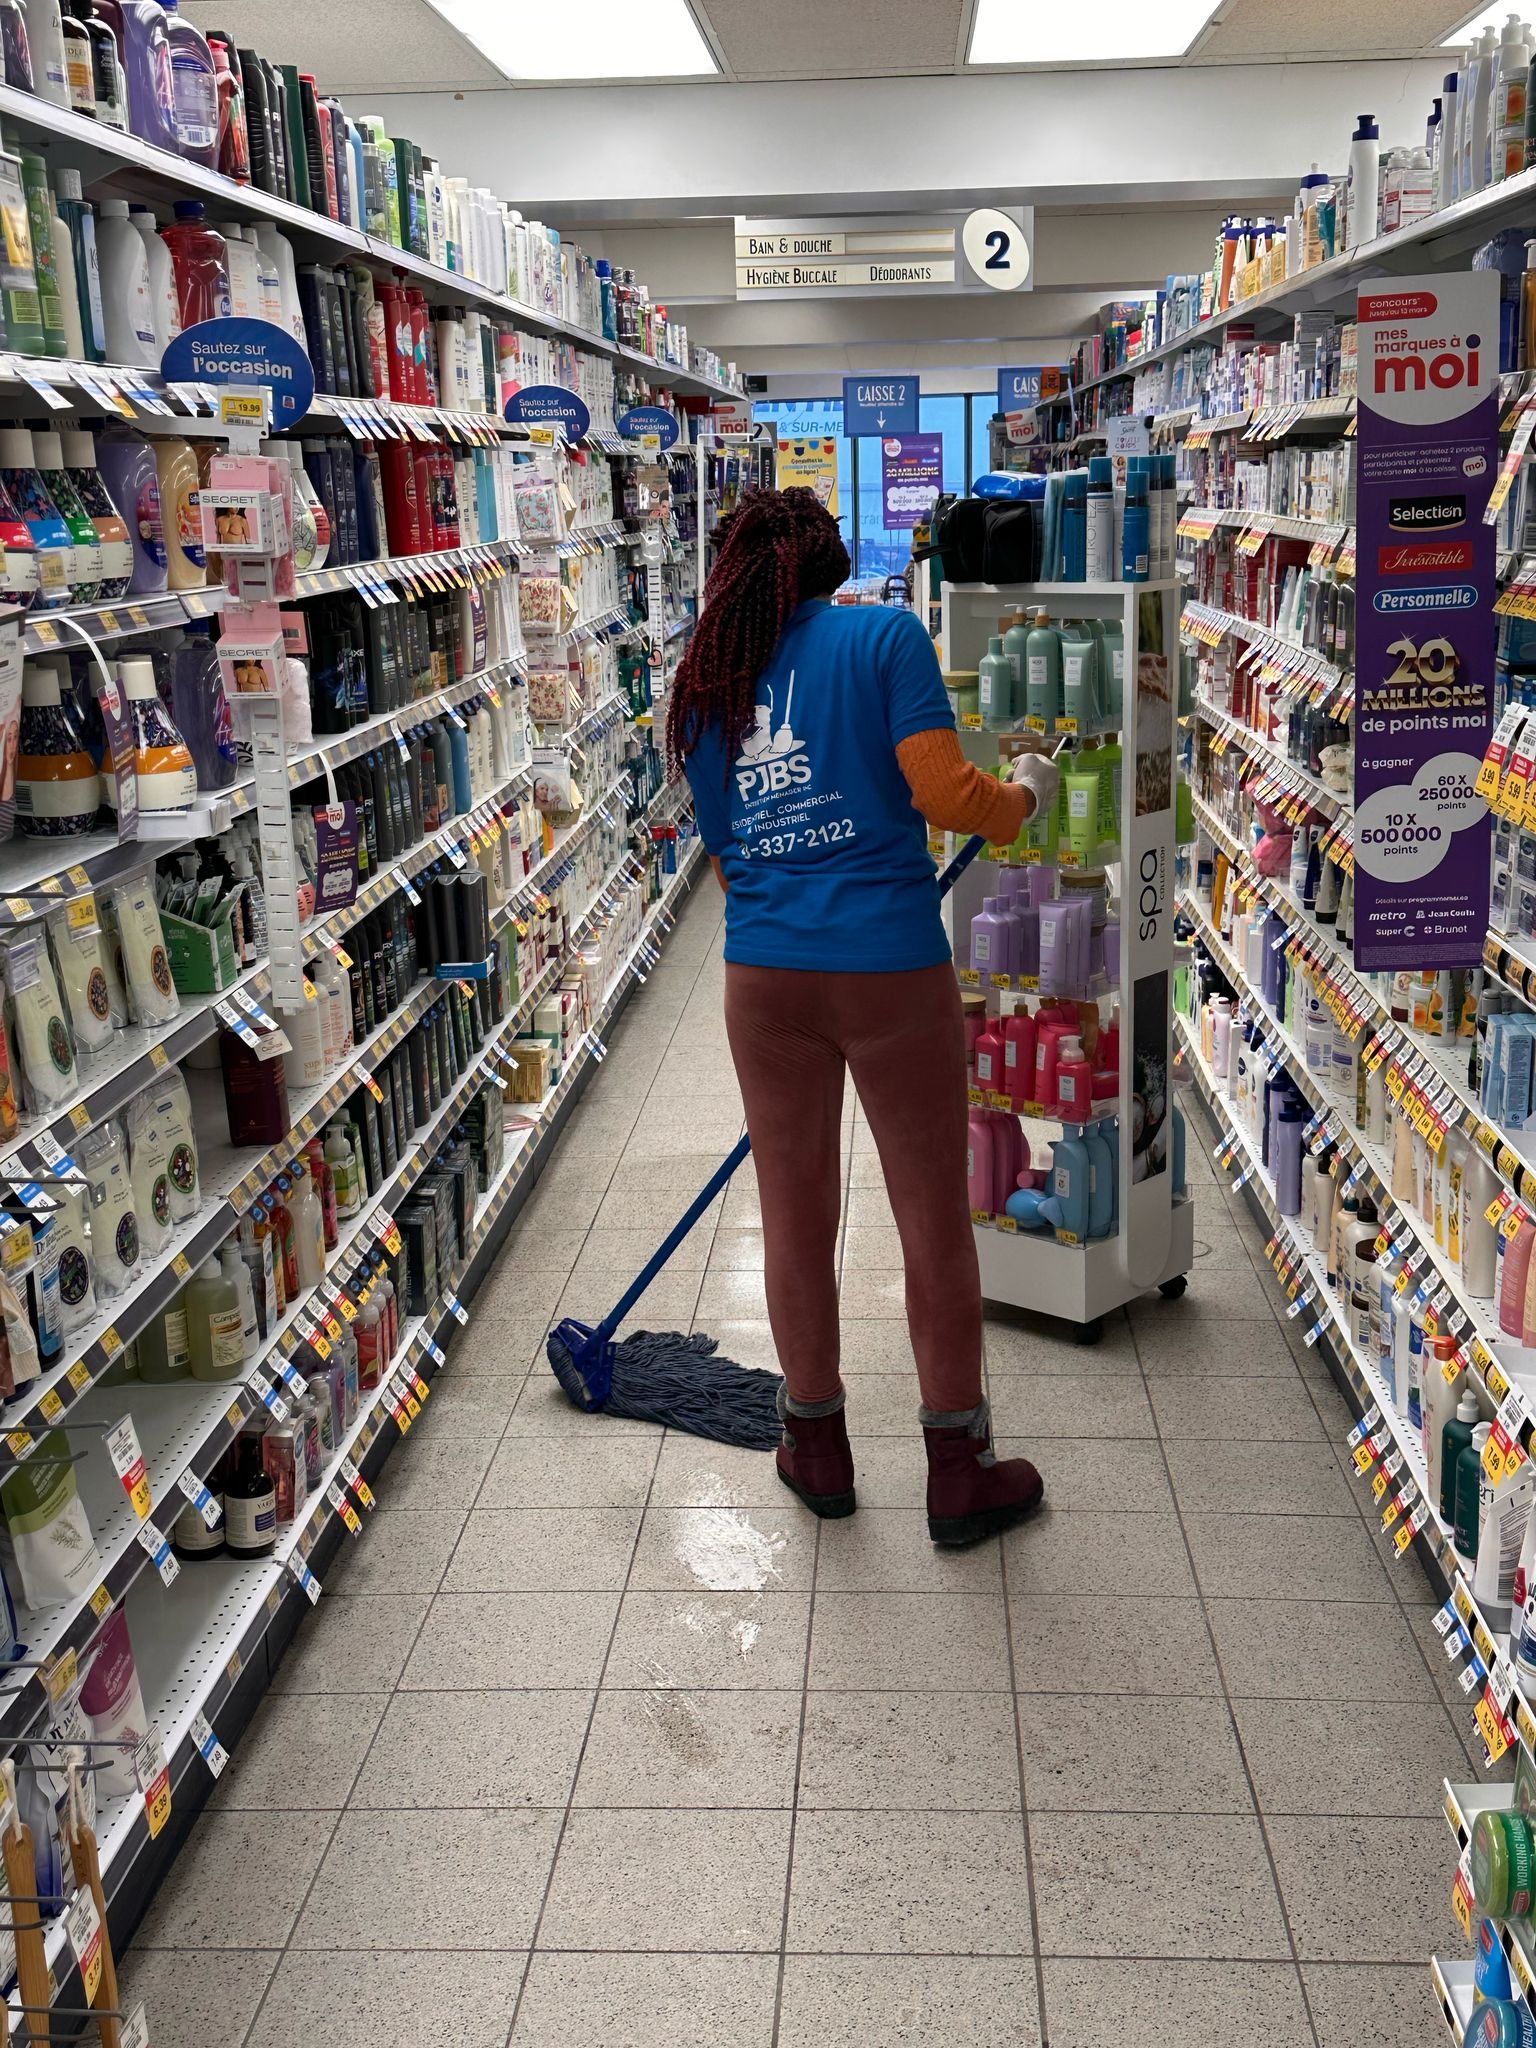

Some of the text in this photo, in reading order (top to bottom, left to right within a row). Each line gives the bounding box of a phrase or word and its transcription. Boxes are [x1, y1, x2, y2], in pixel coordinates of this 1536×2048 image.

[779, 238, 788, 253] &
[984, 230, 1011, 269] 2
[1374, 329, 1408, 341] mes
[192, 341, 266, 355] Sautez sur
[1375, 334, 1460, 354] marques à
[193, 357, 293, 379] l'occasion
[1374, 334, 1481, 393] moi
[857, 384, 905, 402] CAISSE 2
[238, 404, 260, 413] 19.99
[521, 407, 576, 417] l'occasion
[720, 418, 748, 434] moi
[1011, 422, 1034, 438] moi
[1465, 459, 1484, 472] moi
[202, 494, 256, 504] SECRET
[1392, 505, 1463, 521] Selection
[1380, 589, 1471, 609] Personnelle
[219, 649, 271, 657] SECRET
[1385, 638, 1460, 686] 20
[1361, 684, 1487, 712] MILLIONS
[1361, 710, 1487, 734] de points moi
[1362, 758, 1414, 770] à gagner
[736, 754, 812, 802] PJBS
[1438, 776, 1455, 786] 60
[1481, 767, 1494, 785] 5.99
[1418, 788, 1450, 801] 250
[1509, 780, 1522, 800] 5.99
[777, 791, 843, 815] COMMERCIAL
[1437, 801, 1467, 811] points
[754, 812, 811, 833] INDUSTRIEL
[1385, 815, 1402, 826] 10
[1361, 827, 1441, 844] 500 000
[1383, 844, 1418, 856] points
[1140, 848, 1163, 941] spa
[1369, 911, 1407, 921] metro
[1428, 908, 1475, 918] Jean Coutu
[1376, 927, 1402, 936] Super
[152, 1793, 168, 1819] 6.39
[1517, 1842, 1528, 1888] WORKING
